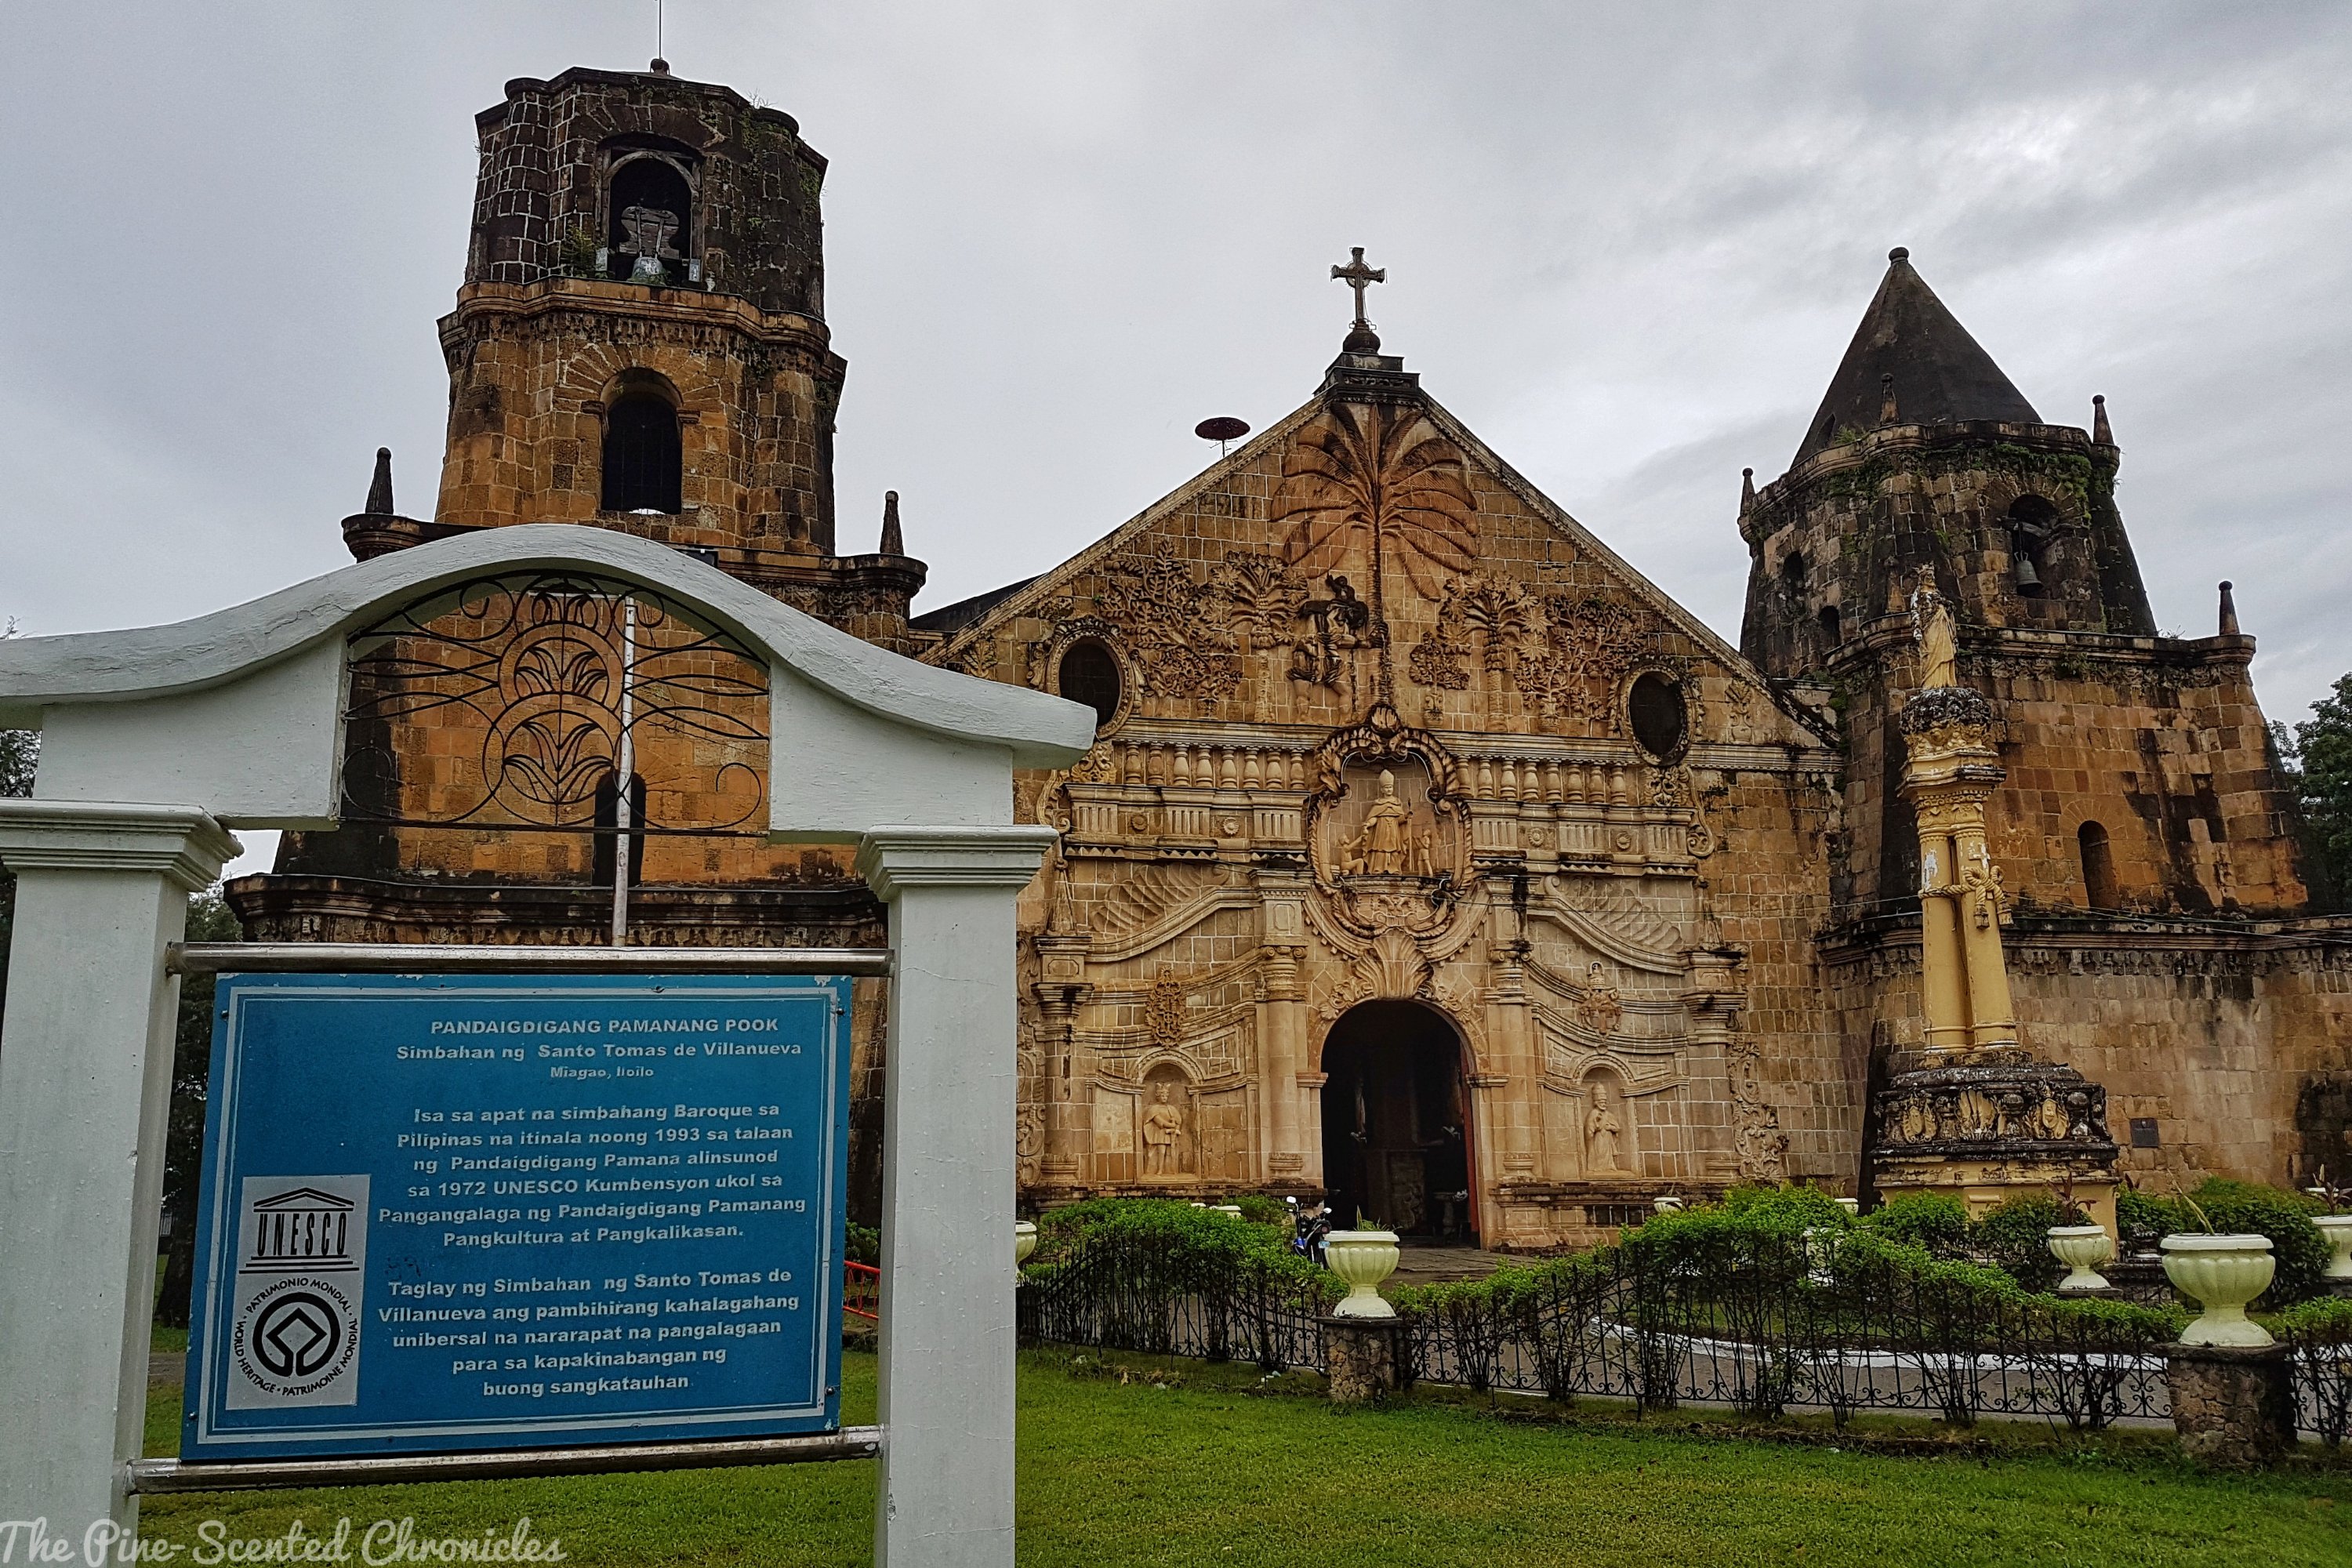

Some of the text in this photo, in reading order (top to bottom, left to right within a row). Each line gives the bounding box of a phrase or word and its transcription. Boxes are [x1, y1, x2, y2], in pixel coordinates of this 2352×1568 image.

[431, 1018, 779, 1034] PANDAIGDIGANG PAMANANG POOK
[397, 1042, 801, 1062] Simbahan ng Santo Tomas de Villanueva
[551, 1065, 654, 1080] Miagao, Iloilo
[415, 1104, 779, 1126] Isa sa apat na simbahang Baroque sa
[397, 1126, 793, 1150] Pilipinas na itinala noong 1993 sa talaan
[414, 1149, 778, 1174] ng Pandaigdigang Pamana alinsunod
[408, 1173, 782, 1197] sa 1972 UNESCO Kumbensyon ukol sa
[379, 1199, 806, 1225] Pangangalaga ng Pandaigdigang Pamanang
[256, 1212, 347, 1256] UNESCO
[445, 1225, 744, 1249] Pangkultura at Pangkalikasan.
[245, 1278, 352, 1313] PATRIMONIO MONDIAL
[388, 1268, 792, 1299] Taglay ng Simbahan ng Santo Tomas de
[379, 1295, 799, 1323] Villanueva ang pambihirang kahalagahang
[394, 1321, 781, 1348] unibersal na nararapat na pangalagaan
[234, 1321, 276, 1393] WORLD HERITAGE
[281, 1318, 358, 1396] PATRIMOINE MONDIAL
[453, 1348, 727, 1375] para sa kapakinabangan ng
[484, 1375, 688, 1398] buong sangkatauhan
